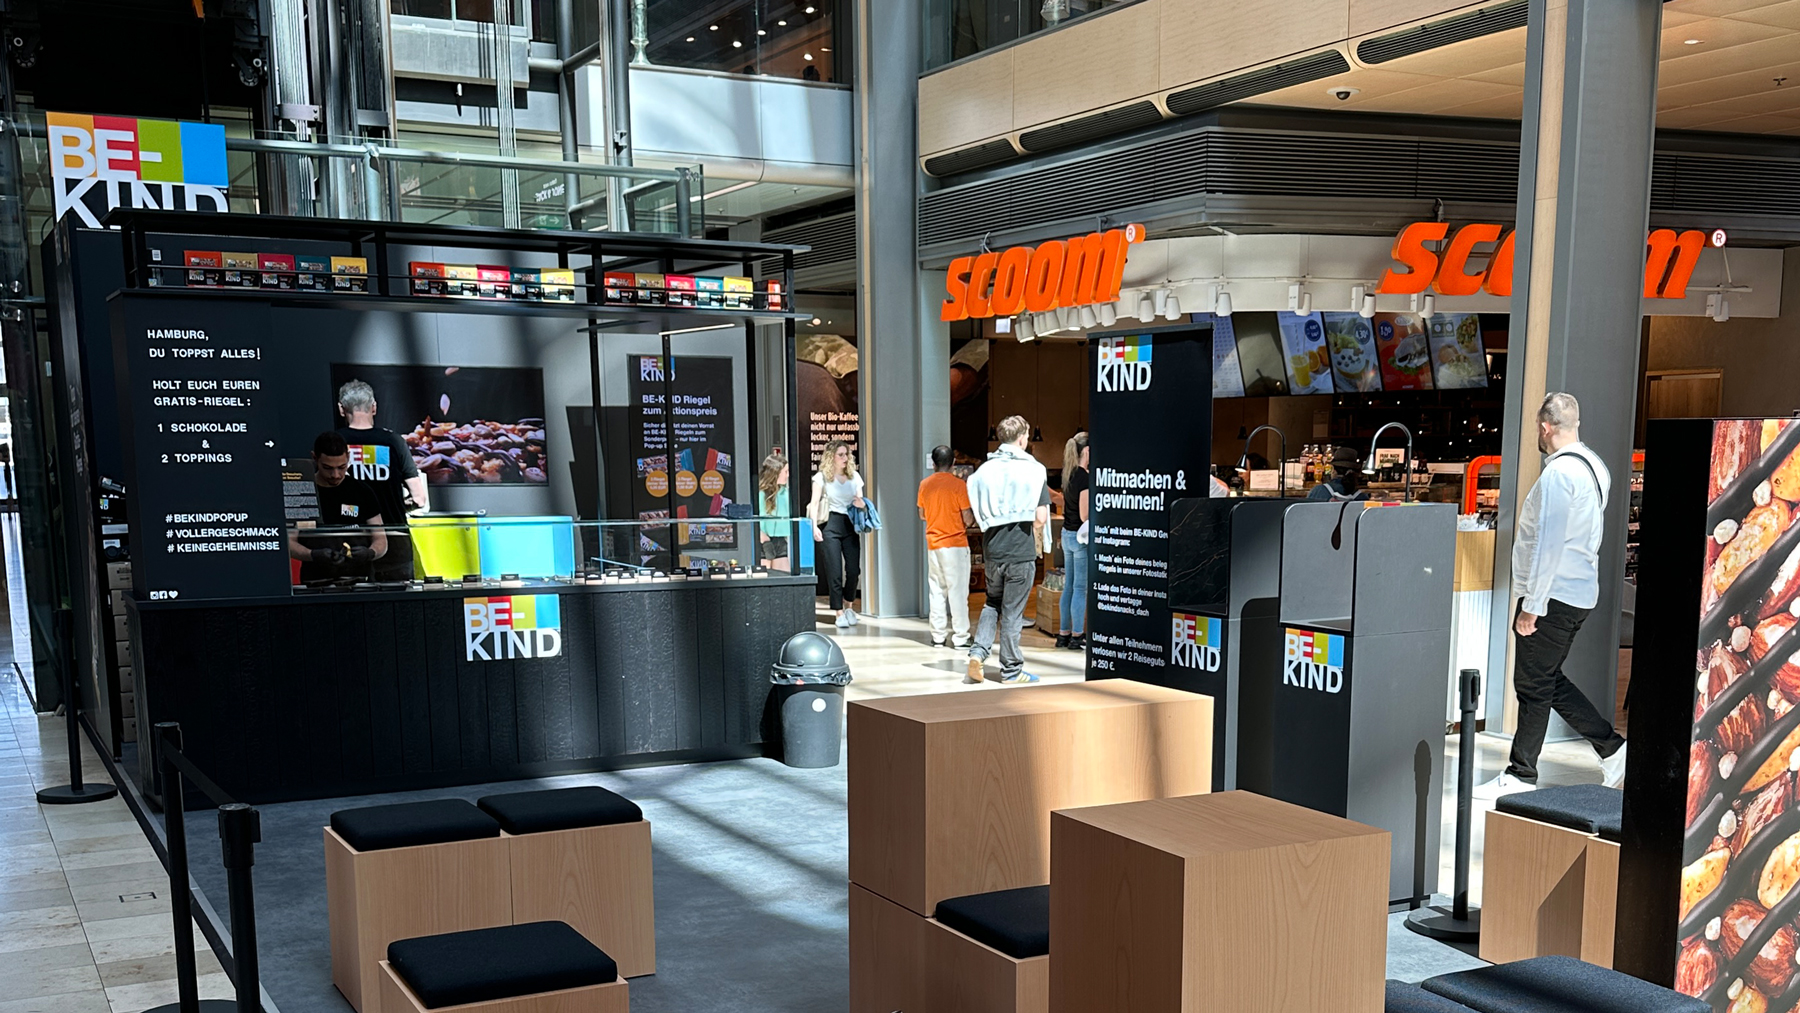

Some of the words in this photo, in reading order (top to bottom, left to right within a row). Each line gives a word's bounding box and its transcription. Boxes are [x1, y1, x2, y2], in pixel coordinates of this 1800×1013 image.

[48, 124, 162, 180] BE-
[1375, 222, 1705, 299] scm
[147, 329, 209, 341] HAMBURG,
[149, 348, 165, 358] DU
[172, 348, 214, 358] TOPPST
[220, 347, 261, 360] ALLES!
[1097, 361, 1152, 392] KIND
[152, 380, 181, 390] HOLT
[187, 380, 217, 390] EUCH
[222, 380, 260, 390] EUREN
[642, 394, 681, 403] BE-KD
[683, 395, 711, 405] Riegel
[642, 407, 661, 415] zum
[663, 406, 717, 417] tionspreis
[810, 412, 827, 421] Unser
[828, 412, 859, 421] Bio-Kaffee
[157, 423, 163, 432] 1
[170, 423, 247, 432] SCHOKOLADE
[810, 422, 826, 431] nicht
[826, 423, 837, 431] nur
[202, 439, 210, 449] &
[161, 454, 169, 463] 2
[174, 453, 232, 463] TOPPINGS
[349, 448, 371, 464] E-
[1096, 468, 1171, 489] Mitmachen
[1175, 470, 1186, 490] &
[1095, 490, 1164, 512] gewinnen!
[165, 513, 248, 523] #BEKINDPOPUP
[166, 528, 279, 539] #VOLLERGESCHMACK
[1110, 526, 1119, 535] mit
[1119, 527, 1133, 536] beim
[1133, 528, 1158, 538] BE-KIND
[1114, 555, 1122, 564] ein
[1122, 556, 1135, 565] Foto
[1135, 558, 1152, 567] deines
[1122, 567, 1142, 576] unserer
[1098, 583, 1110, 592] Lade
[1110, 584, 1120, 593] das
[1120, 585, 1132, 594] Foto
[1132, 587, 1137, 595] in
[1137, 588, 1154, 597] deiner
[1097, 592, 1110, 601] hoch
[1110, 595, 1120, 603] und
[464, 602, 525, 633] BE-
[1172, 617, 1203, 644] BE-
[466, 628, 561, 661] KIND
[1092, 631, 1108, 643] Unter
[1108, 635, 1124, 646] allen
[1124, 637, 1163, 653] Teilnehmern
[1285, 632, 1322, 663] BE-
[1091, 646, 1116, 658] verlosen
[1117, 650, 1127, 660] wir
[1127, 651, 1133, 661] 2
[1171, 641, 1222, 673] KIND
[1091, 658, 1097, 669] je
[1097, 659, 1109, 670] 250
[1283, 658, 1343, 694] KIND
